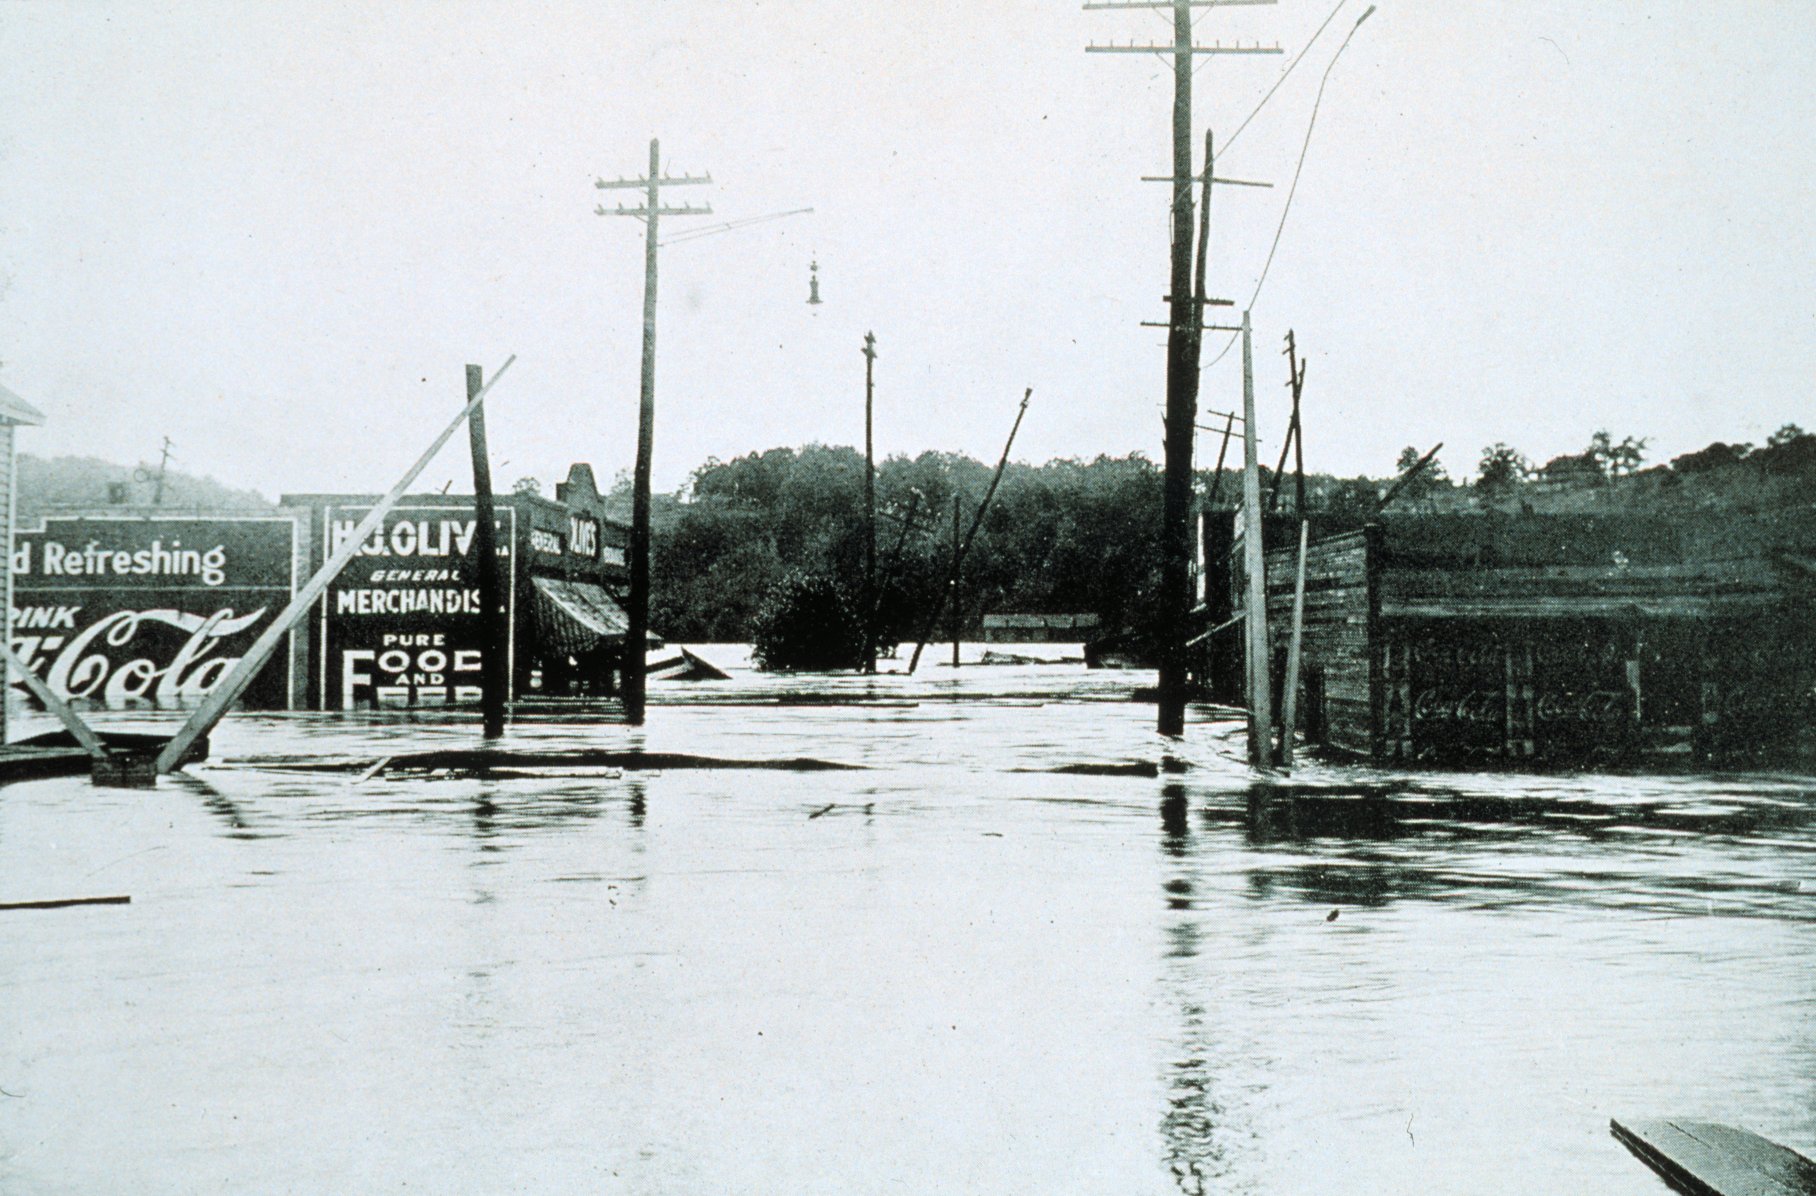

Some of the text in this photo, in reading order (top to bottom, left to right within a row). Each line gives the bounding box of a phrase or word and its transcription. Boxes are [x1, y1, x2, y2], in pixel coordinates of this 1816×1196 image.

[44, 539, 226, 586] Refreshing
[370, 569, 462, 582] GENERAL
[337, 588, 506, 615] MERCHANDIS.
[382, 634, 446, 647] PURE
[395, 673, 446, 686] AND
